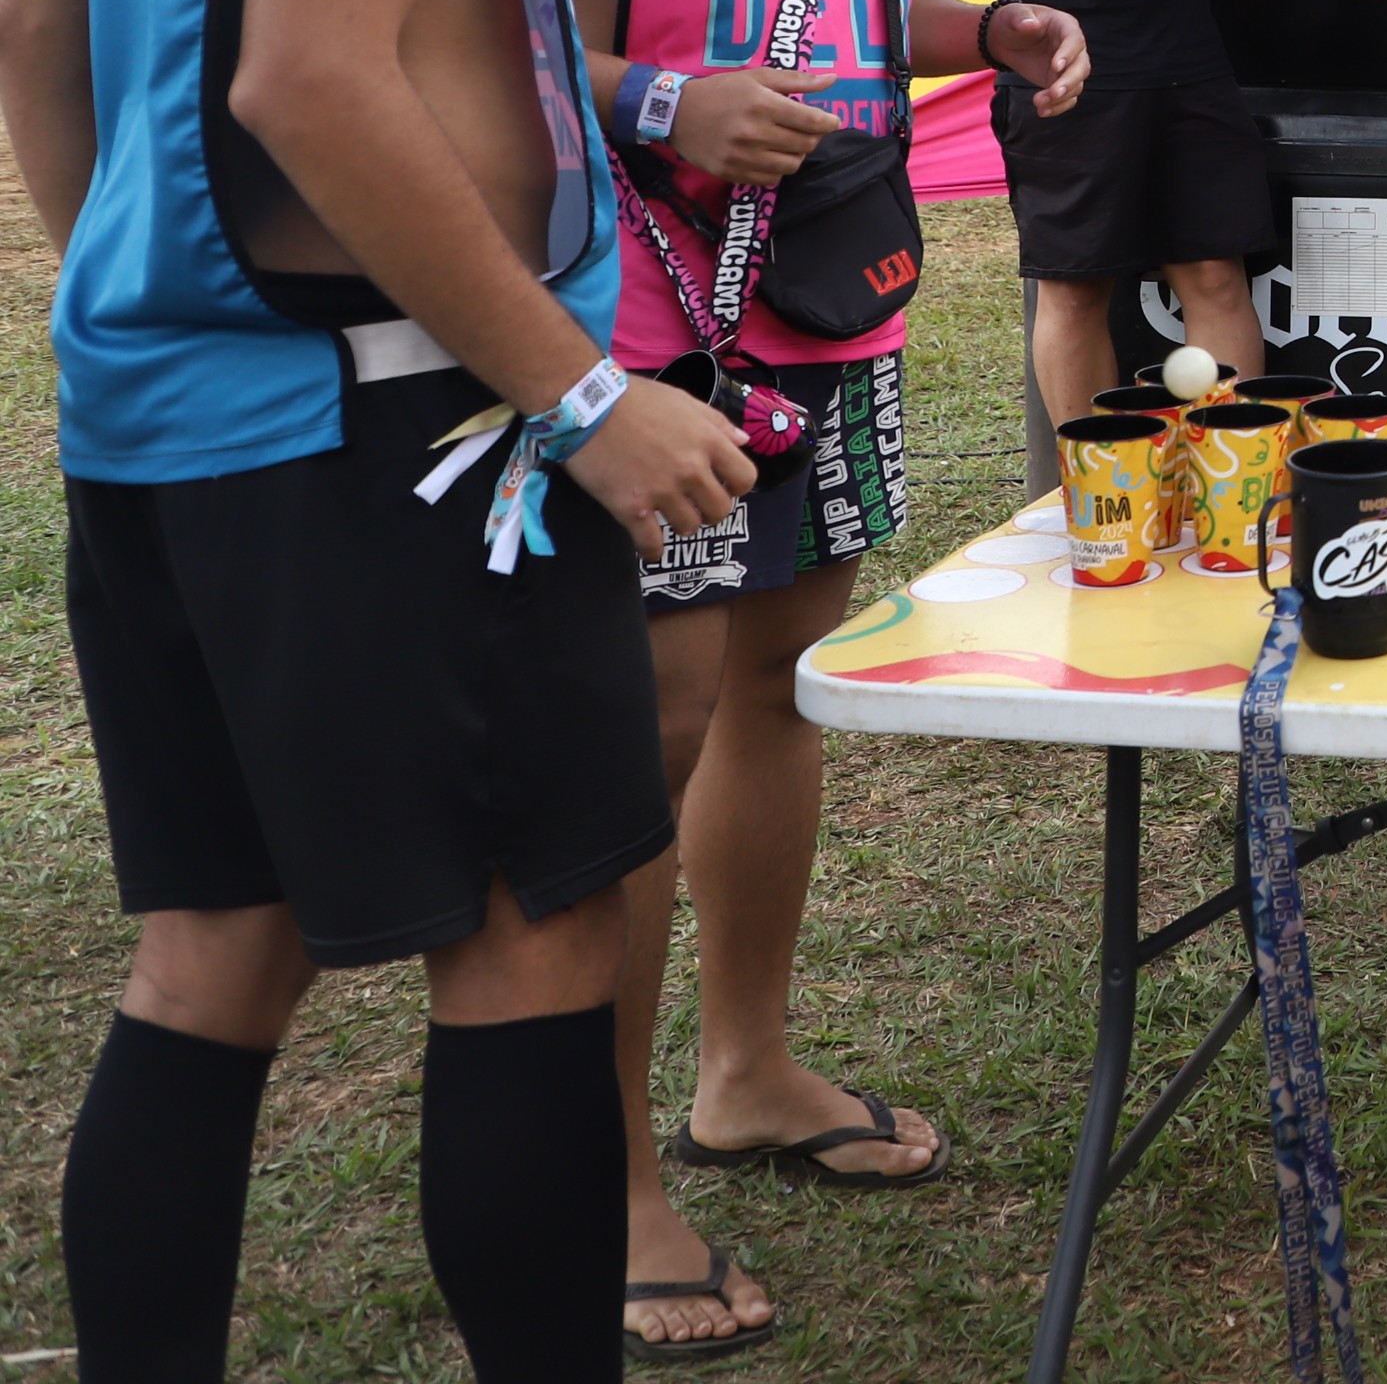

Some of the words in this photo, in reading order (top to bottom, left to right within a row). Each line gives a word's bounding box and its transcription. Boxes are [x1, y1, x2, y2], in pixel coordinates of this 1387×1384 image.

[661, 540, 711, 569] CIVIL
[1099, 523, 1133, 540] 2024
[668, 569, 707, 583] UNICAMP
[1254, 680, 1279, 742] PELOS
[1257, 743, 1284, 807] MEUS
[1278, 935, 1304, 994] HOJE
[1259, 979, 1290, 1074] UNICAMP
[1286, 996, 1317, 1069] ESTOU
[1299, 1070, 1327, 1117] SEM
[1278, 1182, 1316, 1329] ENGENHARIA
